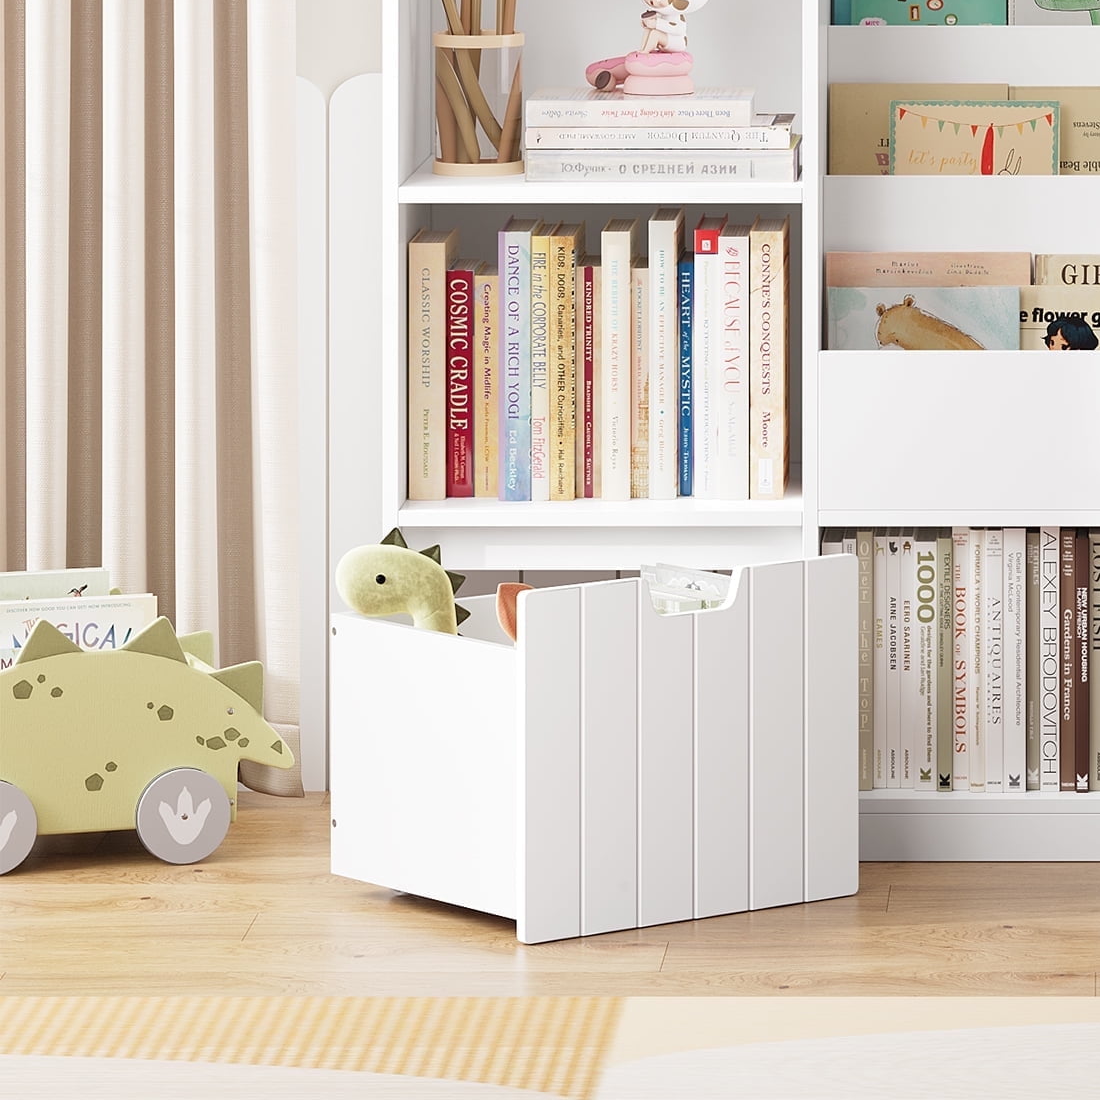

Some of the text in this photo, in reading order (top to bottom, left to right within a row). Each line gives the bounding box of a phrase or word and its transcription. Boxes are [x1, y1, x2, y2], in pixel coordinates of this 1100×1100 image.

[601, 110, 619, 118] Twice
[620, 110, 639, 118] There
[678, 110, 695, 118] Once
[696, 110, 714, 118] There
[1072, 120, 1100, 130] Stevens
[647, 131, 689, 143] DOCTOR
[632, 162, 695, 176] СРЕДНЕЙ
[701, 164, 738, 175] АЗИИ
[940, 151, 979, 175] party
[507, 245, 520, 297] DANCE
[533, 252, 547, 270] FIRE
[556, 246, 565, 270] KIDS,
[533, 273, 547, 282] in
[533, 284, 547, 299] the
[556, 273, 565, 301] DOGS,
[507, 301, 520, 320] OF
[681, 271, 691, 328] HEART
[723, 261, 741, 336] BECAUSE
[421, 268, 431, 388] CLASSIC WORSHIP
[481, 283, 492, 400] Creating Magic in Midlife
[507, 326, 520, 337] A
[533, 301, 547, 359] CORPORATE
[759, 243, 771, 448] CONNIE'S CONQUESTS Moore
[449, 279, 468, 431] COSMIC CRADLE
[507, 342, 520, 378] RICH
[556, 344, 565, 361] and
[610, 332, 619, 361] KRAZY
[533, 362, 547, 389] BELLY
[556, 363, 565, 392] OTHER
[610, 364, 619, 393] HORSE
[681, 355, 691, 417] MYSTIC
[723, 355, 741, 394] YOU
[507, 382, 520, 420] YOGI
[556, 394, 565, 438] Curiosities
[508, 430, 518, 444] Ed
[533, 416, 547, 436] Tom
[1014, 552, 1023, 574] Detail
[1043, 530, 1057, 620] ALEXEY
[916, 550, 935, 624] 1000
[1006, 552, 1014, 612] Virginia McLeod
[954, 587, 967, 639] BOOK
[1013, 584, 1022, 637] Contemporary
[875, 618, 883, 649] EAMES
[889, 596, 897, 671] ARNE JACOBSEN
[903, 600, 911, 672] EERO SAARINEN
[1014, 638, 1023, 680] Residential
[1063, 608, 1073, 721] Gardens in France
[954, 660, 967, 754] SYMBOLS
[1014, 681, 1023, 726] Architecture
[1043, 627, 1057, 775] BRODOVITCH
